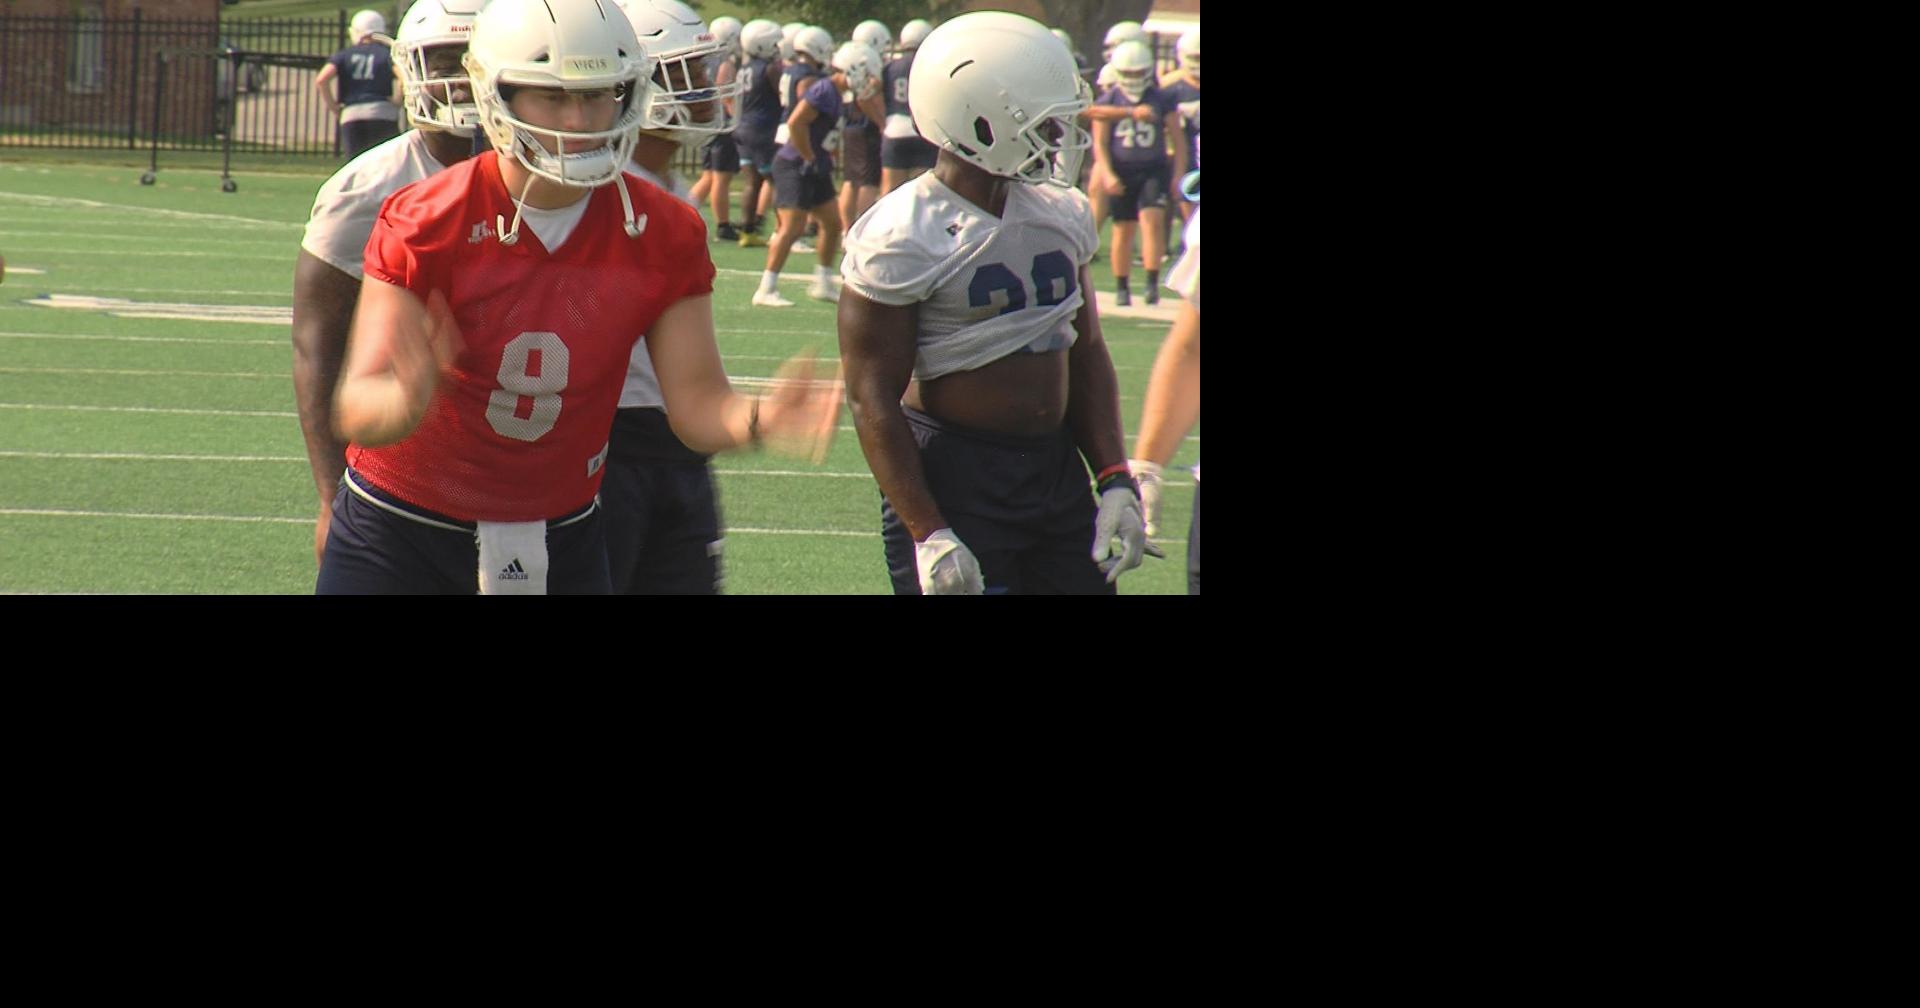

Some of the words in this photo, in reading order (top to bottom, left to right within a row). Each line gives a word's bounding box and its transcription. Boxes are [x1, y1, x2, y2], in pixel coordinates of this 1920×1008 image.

[351, 54, 375, 80] 71
[1114, 117, 1155, 147] 45
[485, 331, 570, 442] 8
